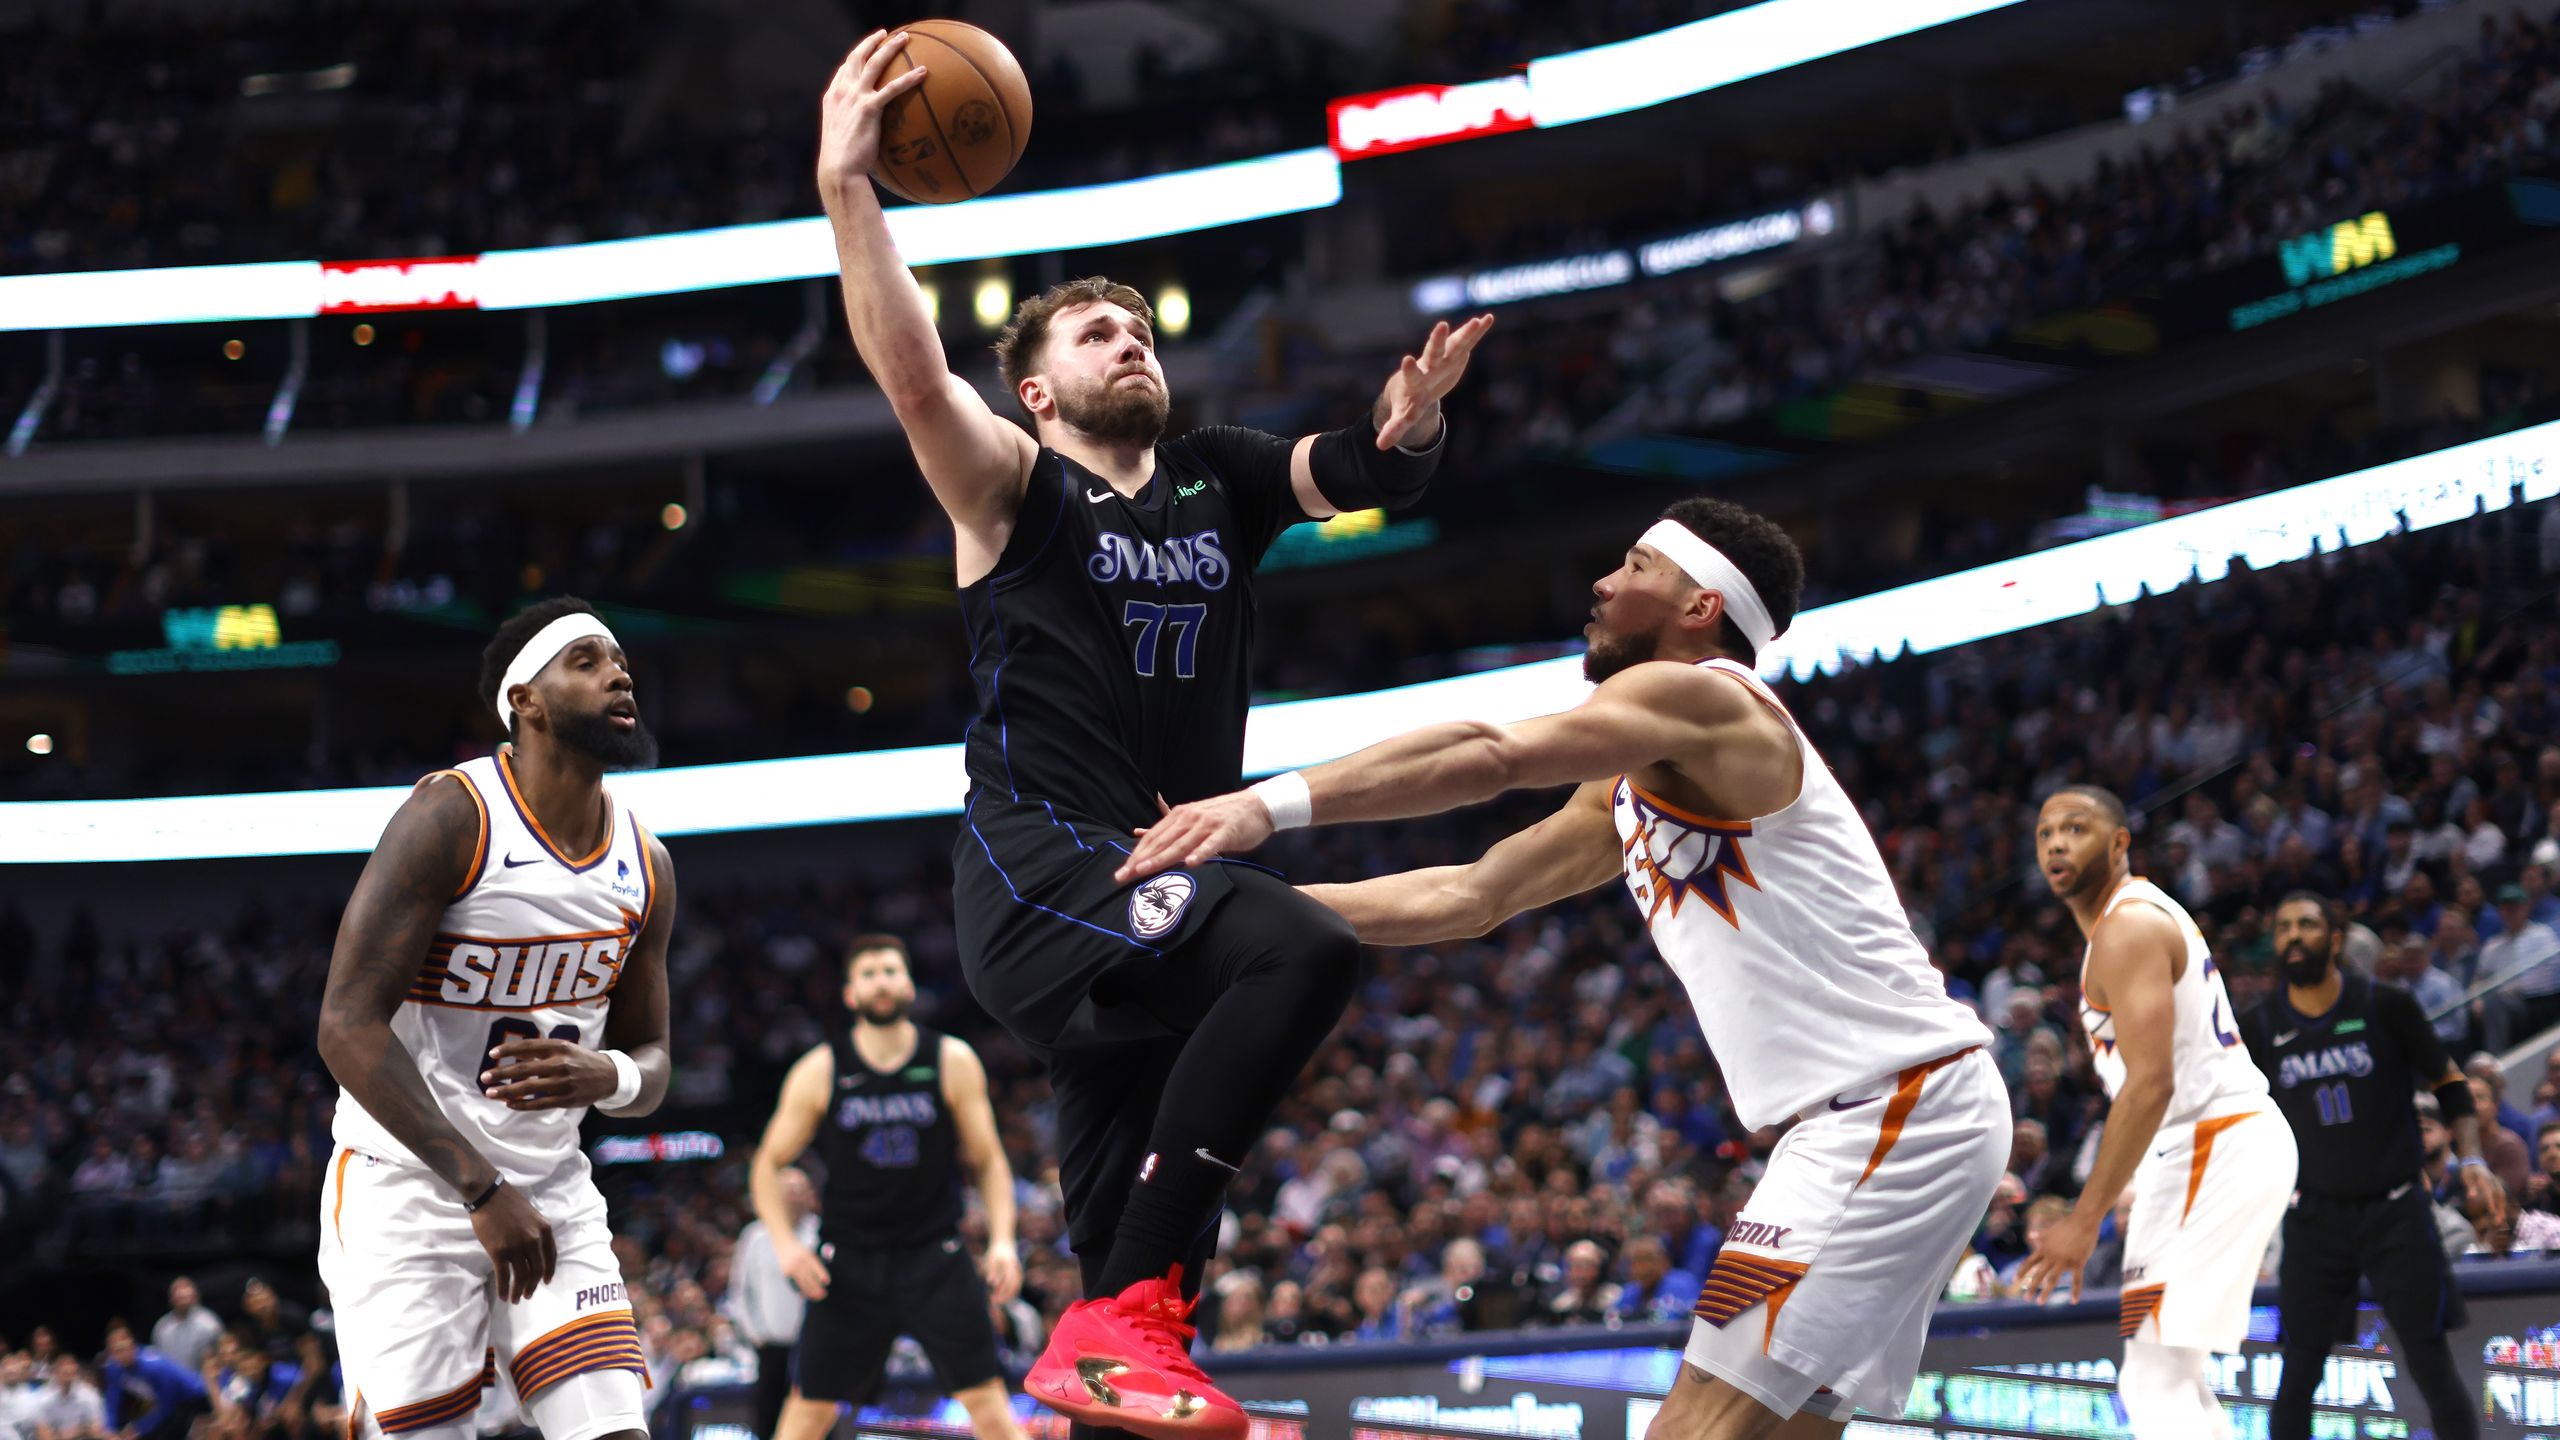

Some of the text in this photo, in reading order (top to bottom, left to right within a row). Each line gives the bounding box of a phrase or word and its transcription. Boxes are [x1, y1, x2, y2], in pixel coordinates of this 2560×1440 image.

[2280, 211, 2397, 287] WM
[1088, 528, 1230, 592] MAVS
[1123, 599, 1207, 679] 77
[611, 882, 640, 898] PayPal
[439, 937, 621, 1008] SUNS
[2279, 1041, 2374, 1088] MAVS
[837, 1091, 937, 1131] MAVS
[2315, 1081, 2354, 1126] 11
[861, 1127, 919, 1167] 42
